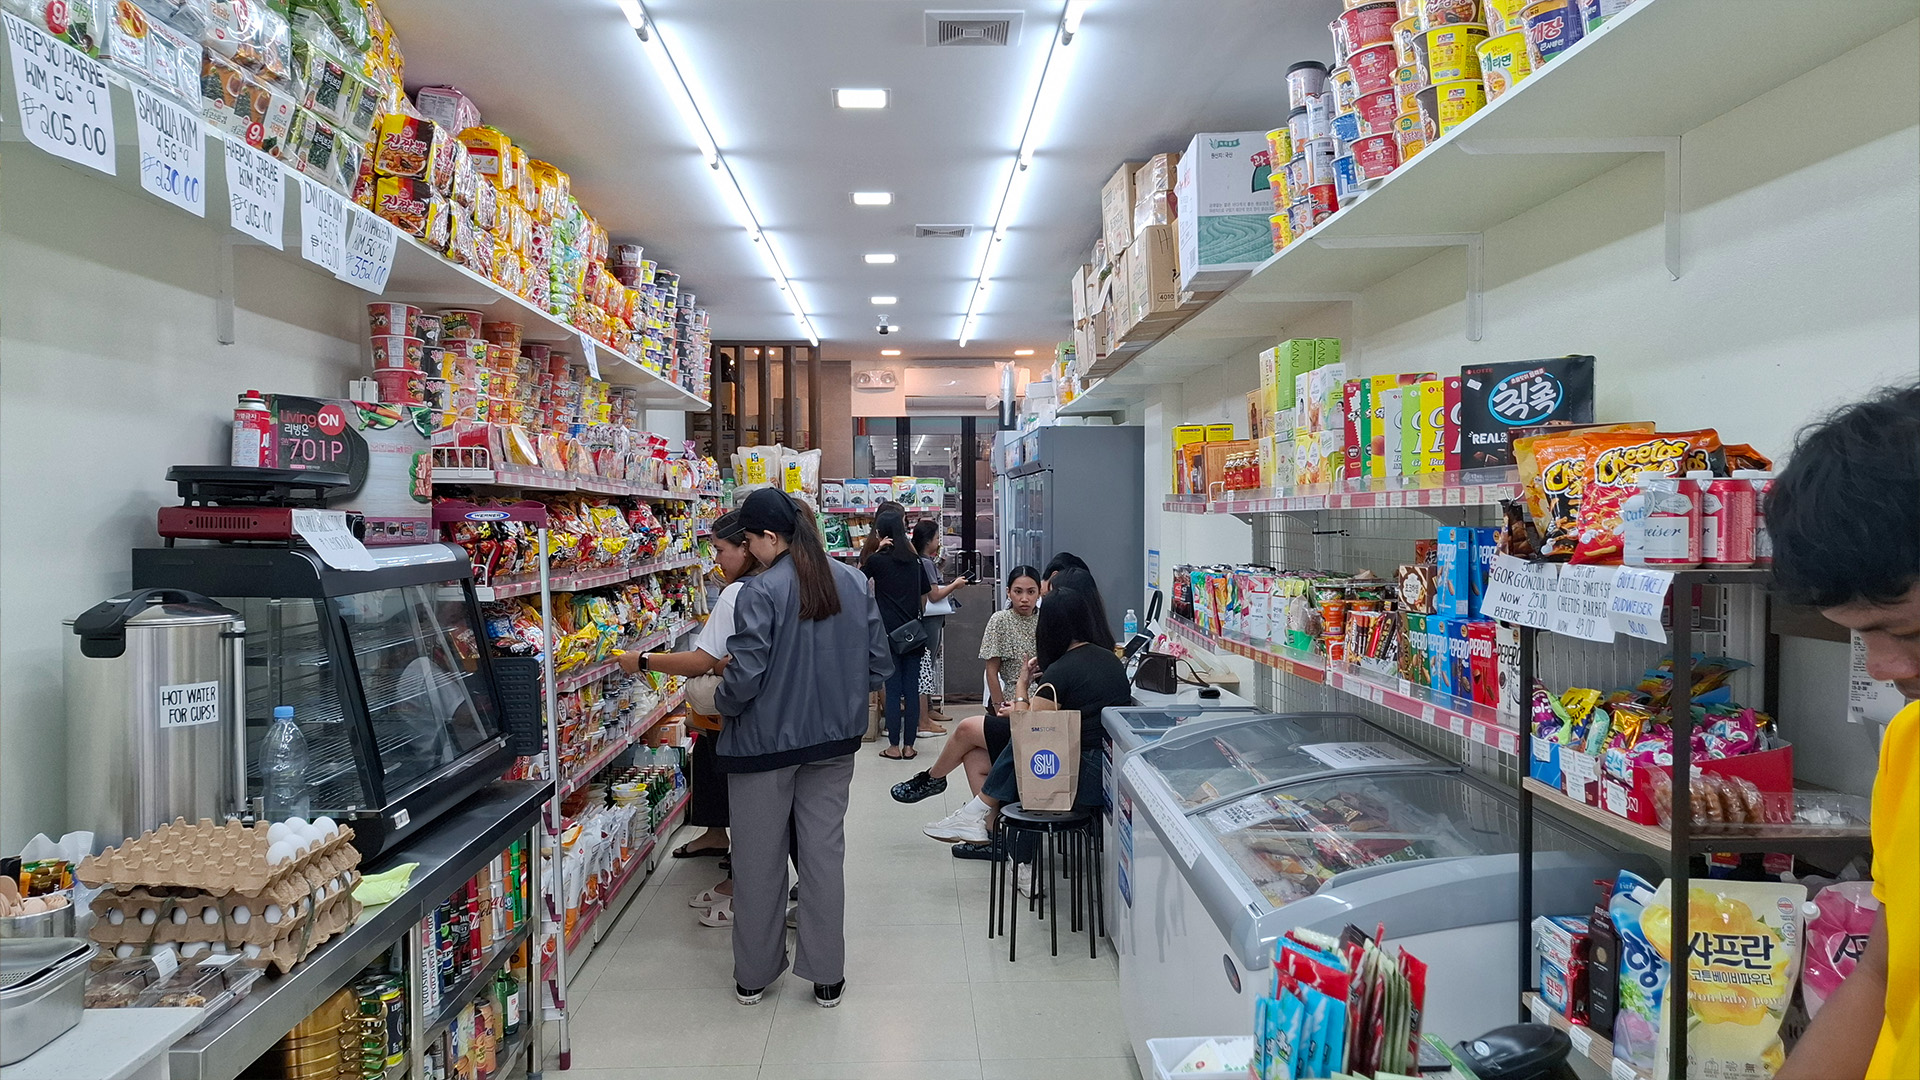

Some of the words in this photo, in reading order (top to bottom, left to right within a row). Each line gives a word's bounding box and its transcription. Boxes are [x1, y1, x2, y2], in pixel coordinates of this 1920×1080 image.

[3, 15, 61, 67] HAEPYO
[63, 48, 106, 88] PARAE
[23, 58, 49, 94] KIM
[178, 113, 198, 151] KIM
[383, 131, 428, 156] 진짬뽕
[380, 193, 426, 216] 진짬뽕
[281, 409, 317, 428] Living
[318, 413, 339, 427] ON
[284, 423, 310, 437] 리빙온
[1472, 432, 1501, 444] REAL
[289, 438, 344, 462] 701P
[1591, 440, 1685, 484] Cheetos
[1437, 543, 1457, 562] PEPERO
[1611, 596, 1653, 616] BUDWEISER
[1470, 639, 1492, 659] PEPERO
[162, 689, 183, 706] HOT
[186, 686, 216, 704] WATER
[169, 707, 188, 724] FOR
[190, 704, 216, 721] CUPS!
